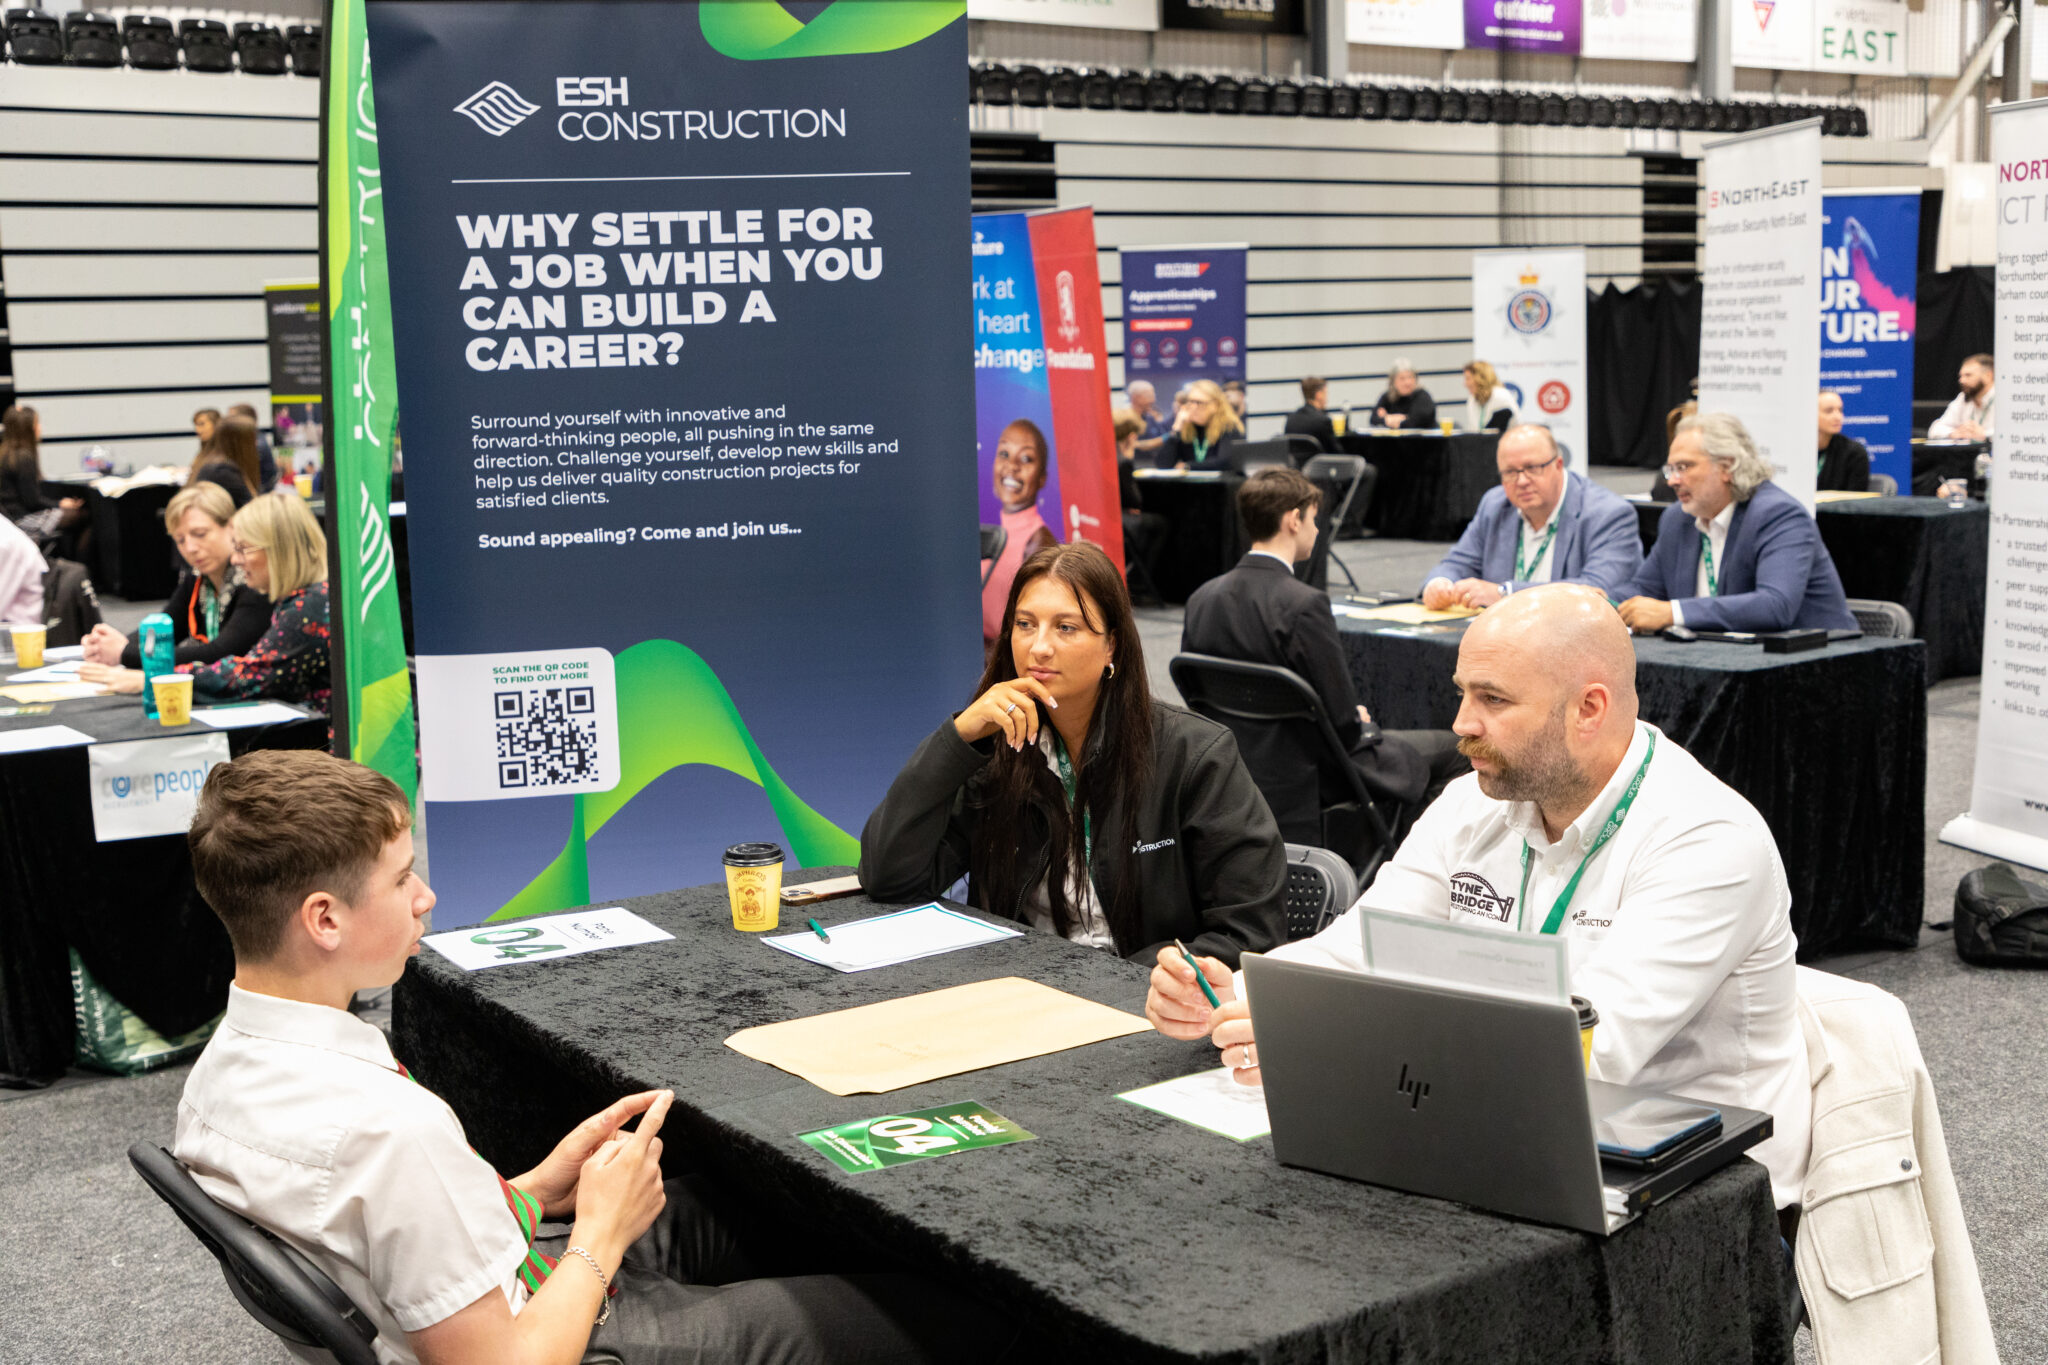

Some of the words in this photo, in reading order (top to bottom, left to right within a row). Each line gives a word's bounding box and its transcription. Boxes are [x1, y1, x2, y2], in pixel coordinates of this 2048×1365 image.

[1823, 27, 1898, 62] EAST
[556, 76, 628, 106] ESH
[558, 108, 845, 141] CONSTRUCTION
[455, 213, 579, 249] WHY
[591, 209, 764, 247] SETTLE
[778, 207, 873, 242] FOR
[459, 255, 498, 290] A
[508, 253, 607, 289] JOB
[619, 249, 770, 286] WHEN
[782, 247, 882, 282] YOU
[994, 277, 1015, 299] at
[462, 294, 566, 331] CAN
[581, 291, 726, 327] BUILD
[739, 289, 776, 323] A
[978, 308, 1030, 334] heart
[465, 331, 684, 371] CAREER?
[471, 412, 550, 429] Surround
[554, 409, 621, 429] yourself
[624, 408, 661, 423] with
[666, 405, 750, 422] innovative
[754, 404, 785, 419] and
[472, 430, 615, 449] forward-thinking
[620, 428, 680, 446] people,
[684, 426, 702, 441] all
[707, 424, 774, 443] pushing
[779, 423, 793, 437] in
[798, 422, 825, 437] the
[829, 423, 874, 436] same
[2023, 434, 2046, 444] work
[473, 452, 553, 469] direction.
[557, 450, 641, 466] Challenge
[645, 445, 713, 465] yourself,
[717, 444, 782, 460] develop
[787, 445, 821, 456] new
[825, 440, 864, 455] skills
[867, 439, 898, 454] and
[475, 473, 513, 491] help
[517, 475, 537, 487] us
[540, 470, 596, 486] deliver
[601, 468, 657, 486] quality
[661, 464, 765, 481] construction
[770, 461, 835, 479] projects
[838, 459, 860, 474] for
[476, 491, 546, 509] satisfied
[551, 490, 609, 505] clients.
[478, 531, 535, 548] Sound
[540, 527, 636, 548] appealing?
[641, 526, 691, 540] Come
[695, 522, 728, 538] and
[731, 521, 764, 539] join
[769, 523, 801, 534] us...
[492, 666, 520, 674] SCAN
[523, 664, 541, 672] THE
[544, 663, 559, 672] QR
[561, 661, 588, 670] CODE
[510, 675, 534, 683] FIND
[537, 673, 556, 681] OUT
[560, 671, 588, 680] MORE
[2004, 680, 2041, 696] working
[1450, 879, 1484, 896] TYNE
[1450, 891, 1494, 912] BRIDGE
[470, 927, 567, 959] 04
[869, 1117, 958, 1155] 04
